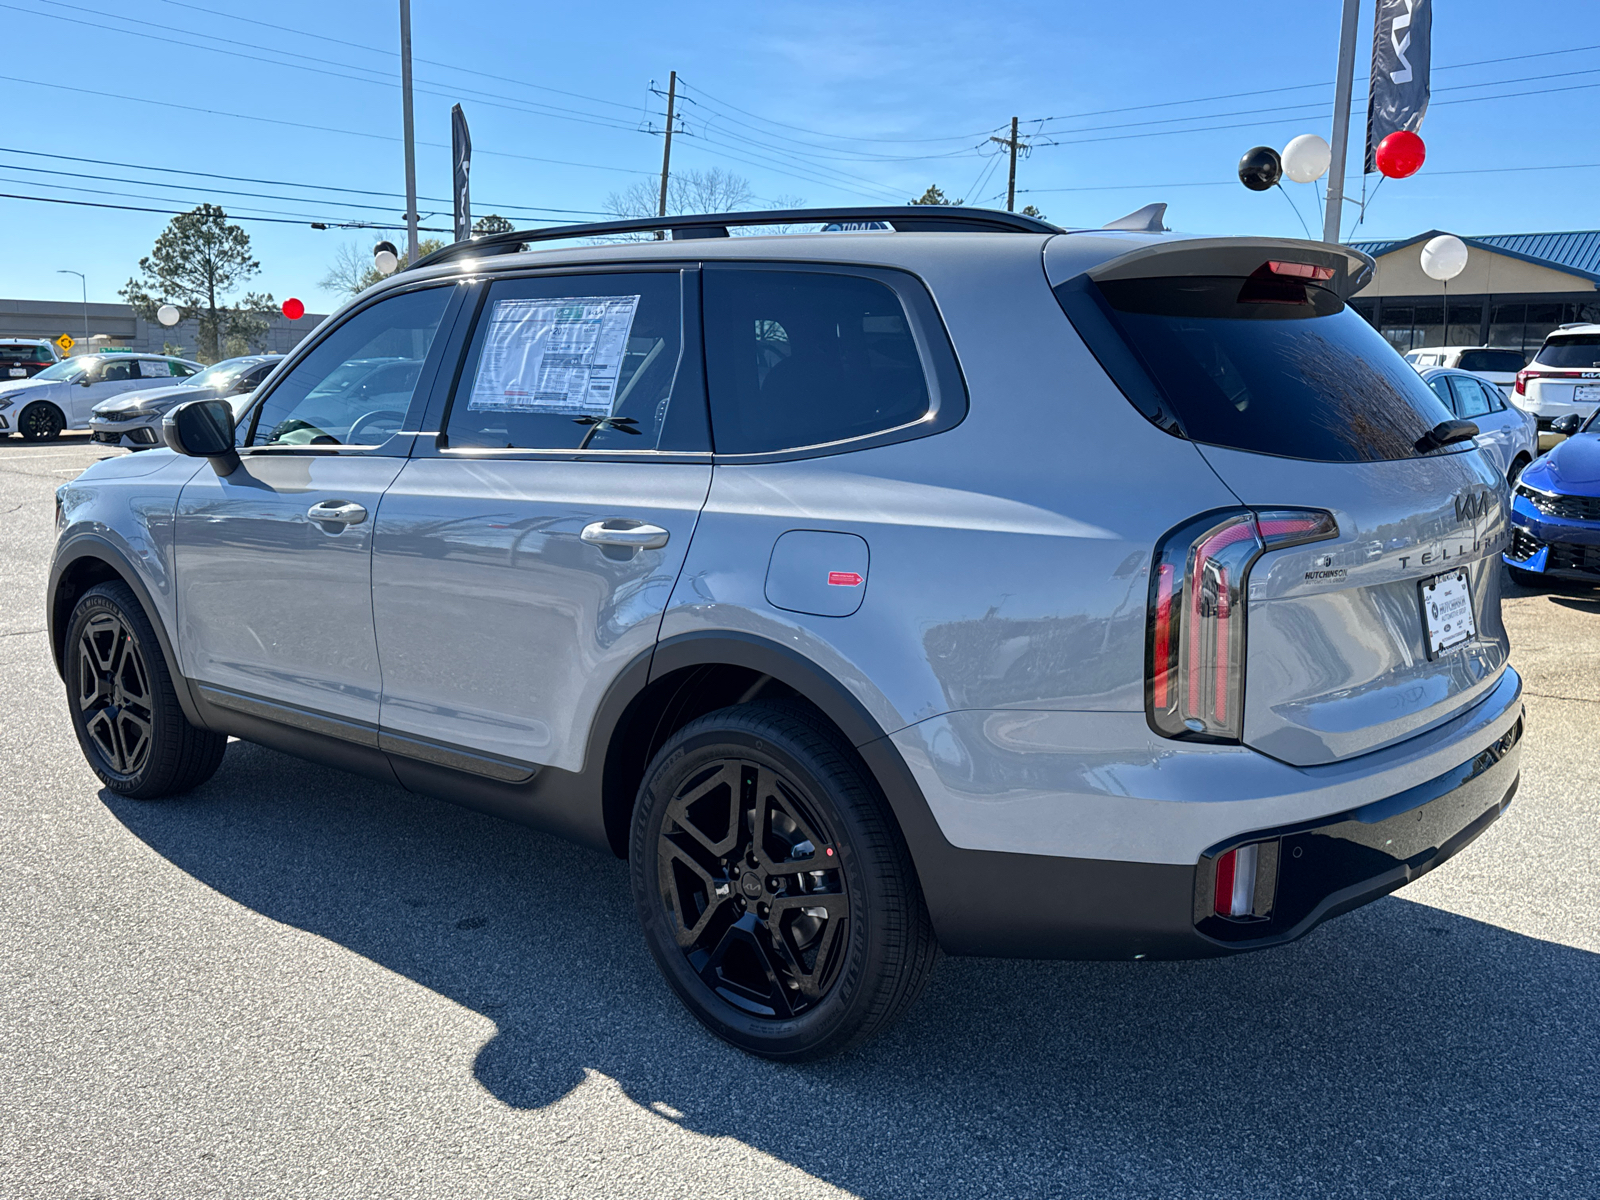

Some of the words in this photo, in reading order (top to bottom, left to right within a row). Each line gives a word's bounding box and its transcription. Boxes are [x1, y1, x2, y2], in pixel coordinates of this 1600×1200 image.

[1389, 0, 1413, 85] KI
[1454, 491, 1489, 522] KIA
[1304, 569, 1348, 580] HUTCHINSON
[85, 597, 119, 613] MICHELIN
[634, 792, 653, 893] MICHELIN
[839, 887, 864, 999] MICHELIN
